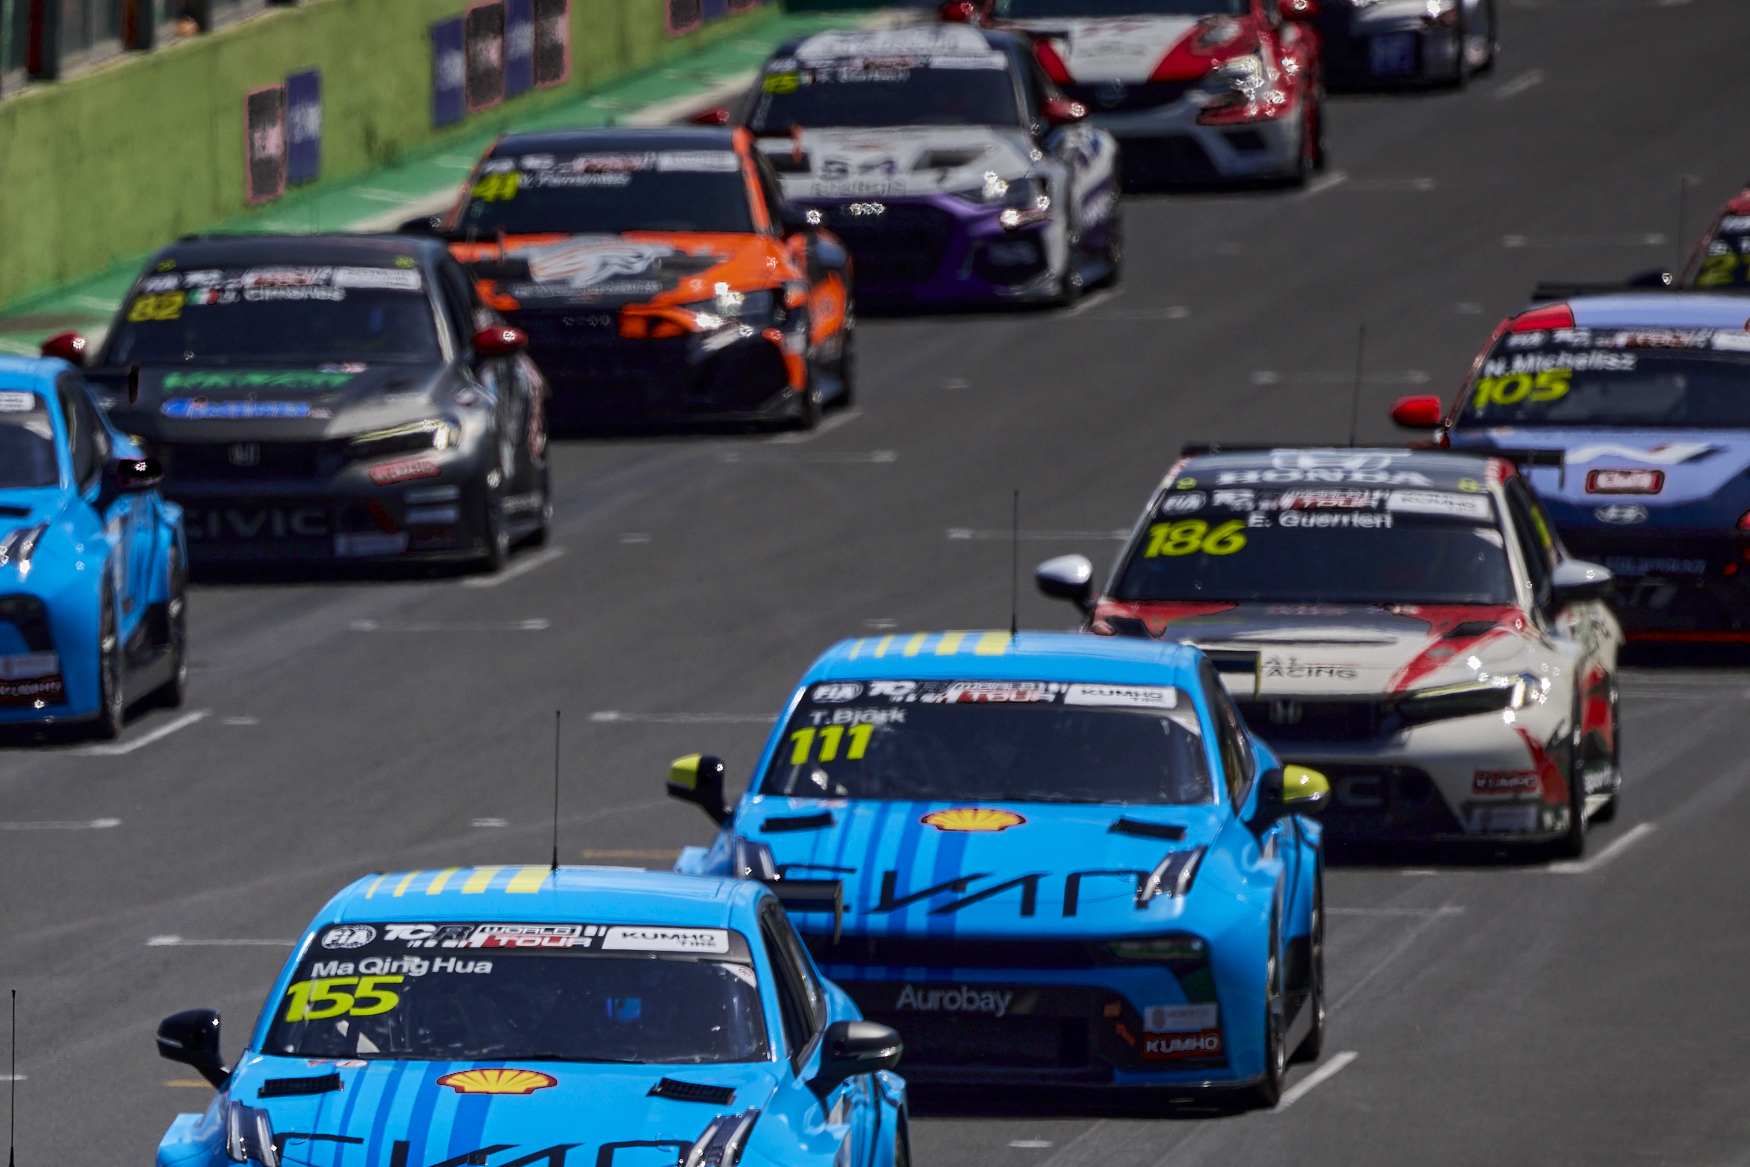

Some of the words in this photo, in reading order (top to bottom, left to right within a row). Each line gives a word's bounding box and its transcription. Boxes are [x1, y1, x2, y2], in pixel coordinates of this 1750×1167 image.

[1472, 367, 1572, 408] 105
[1216, 470, 1434, 486] HONDA
[1146, 518, 1248, 558] 186
[1264, 667, 1357, 679] ACING
[790, 723, 875, 765] 111
[325, 928, 370, 945] FIA
[495, 936, 592, 948] TOUR
[621, 931, 715, 942] KUMHO
[285, 975, 405, 1023] 155
[896, 983, 1013, 1017] Aurobay
